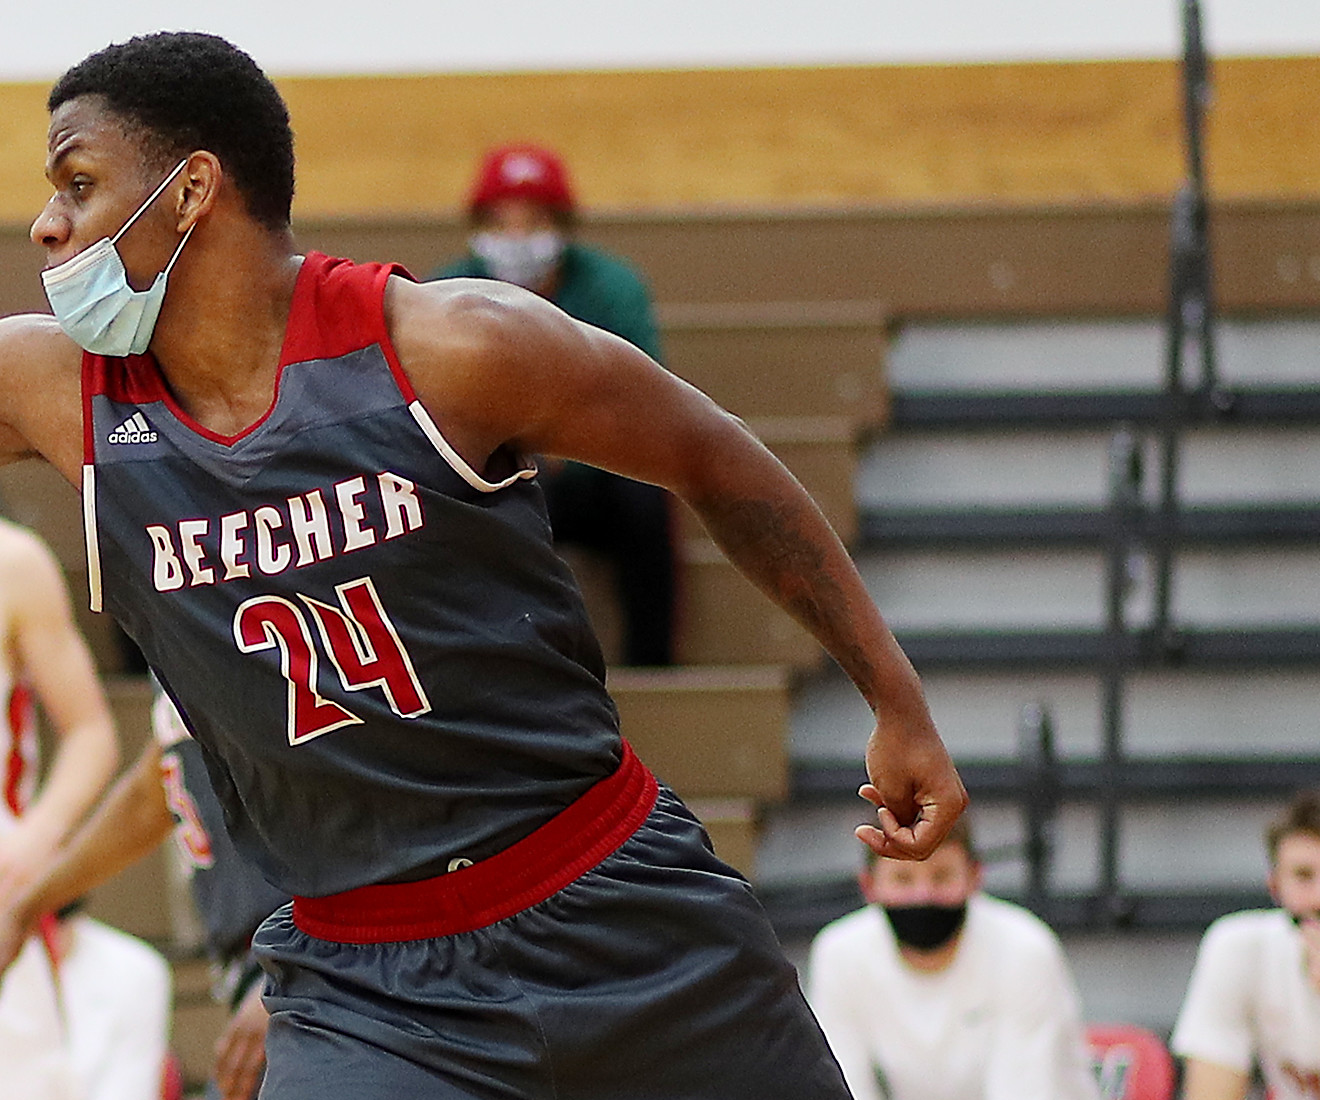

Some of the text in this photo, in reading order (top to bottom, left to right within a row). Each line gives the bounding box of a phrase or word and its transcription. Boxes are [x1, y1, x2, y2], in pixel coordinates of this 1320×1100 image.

[108, 432, 158, 444] adidas
[145, 471, 424, 592] BEECHER
[233, 576, 432, 746] 24
